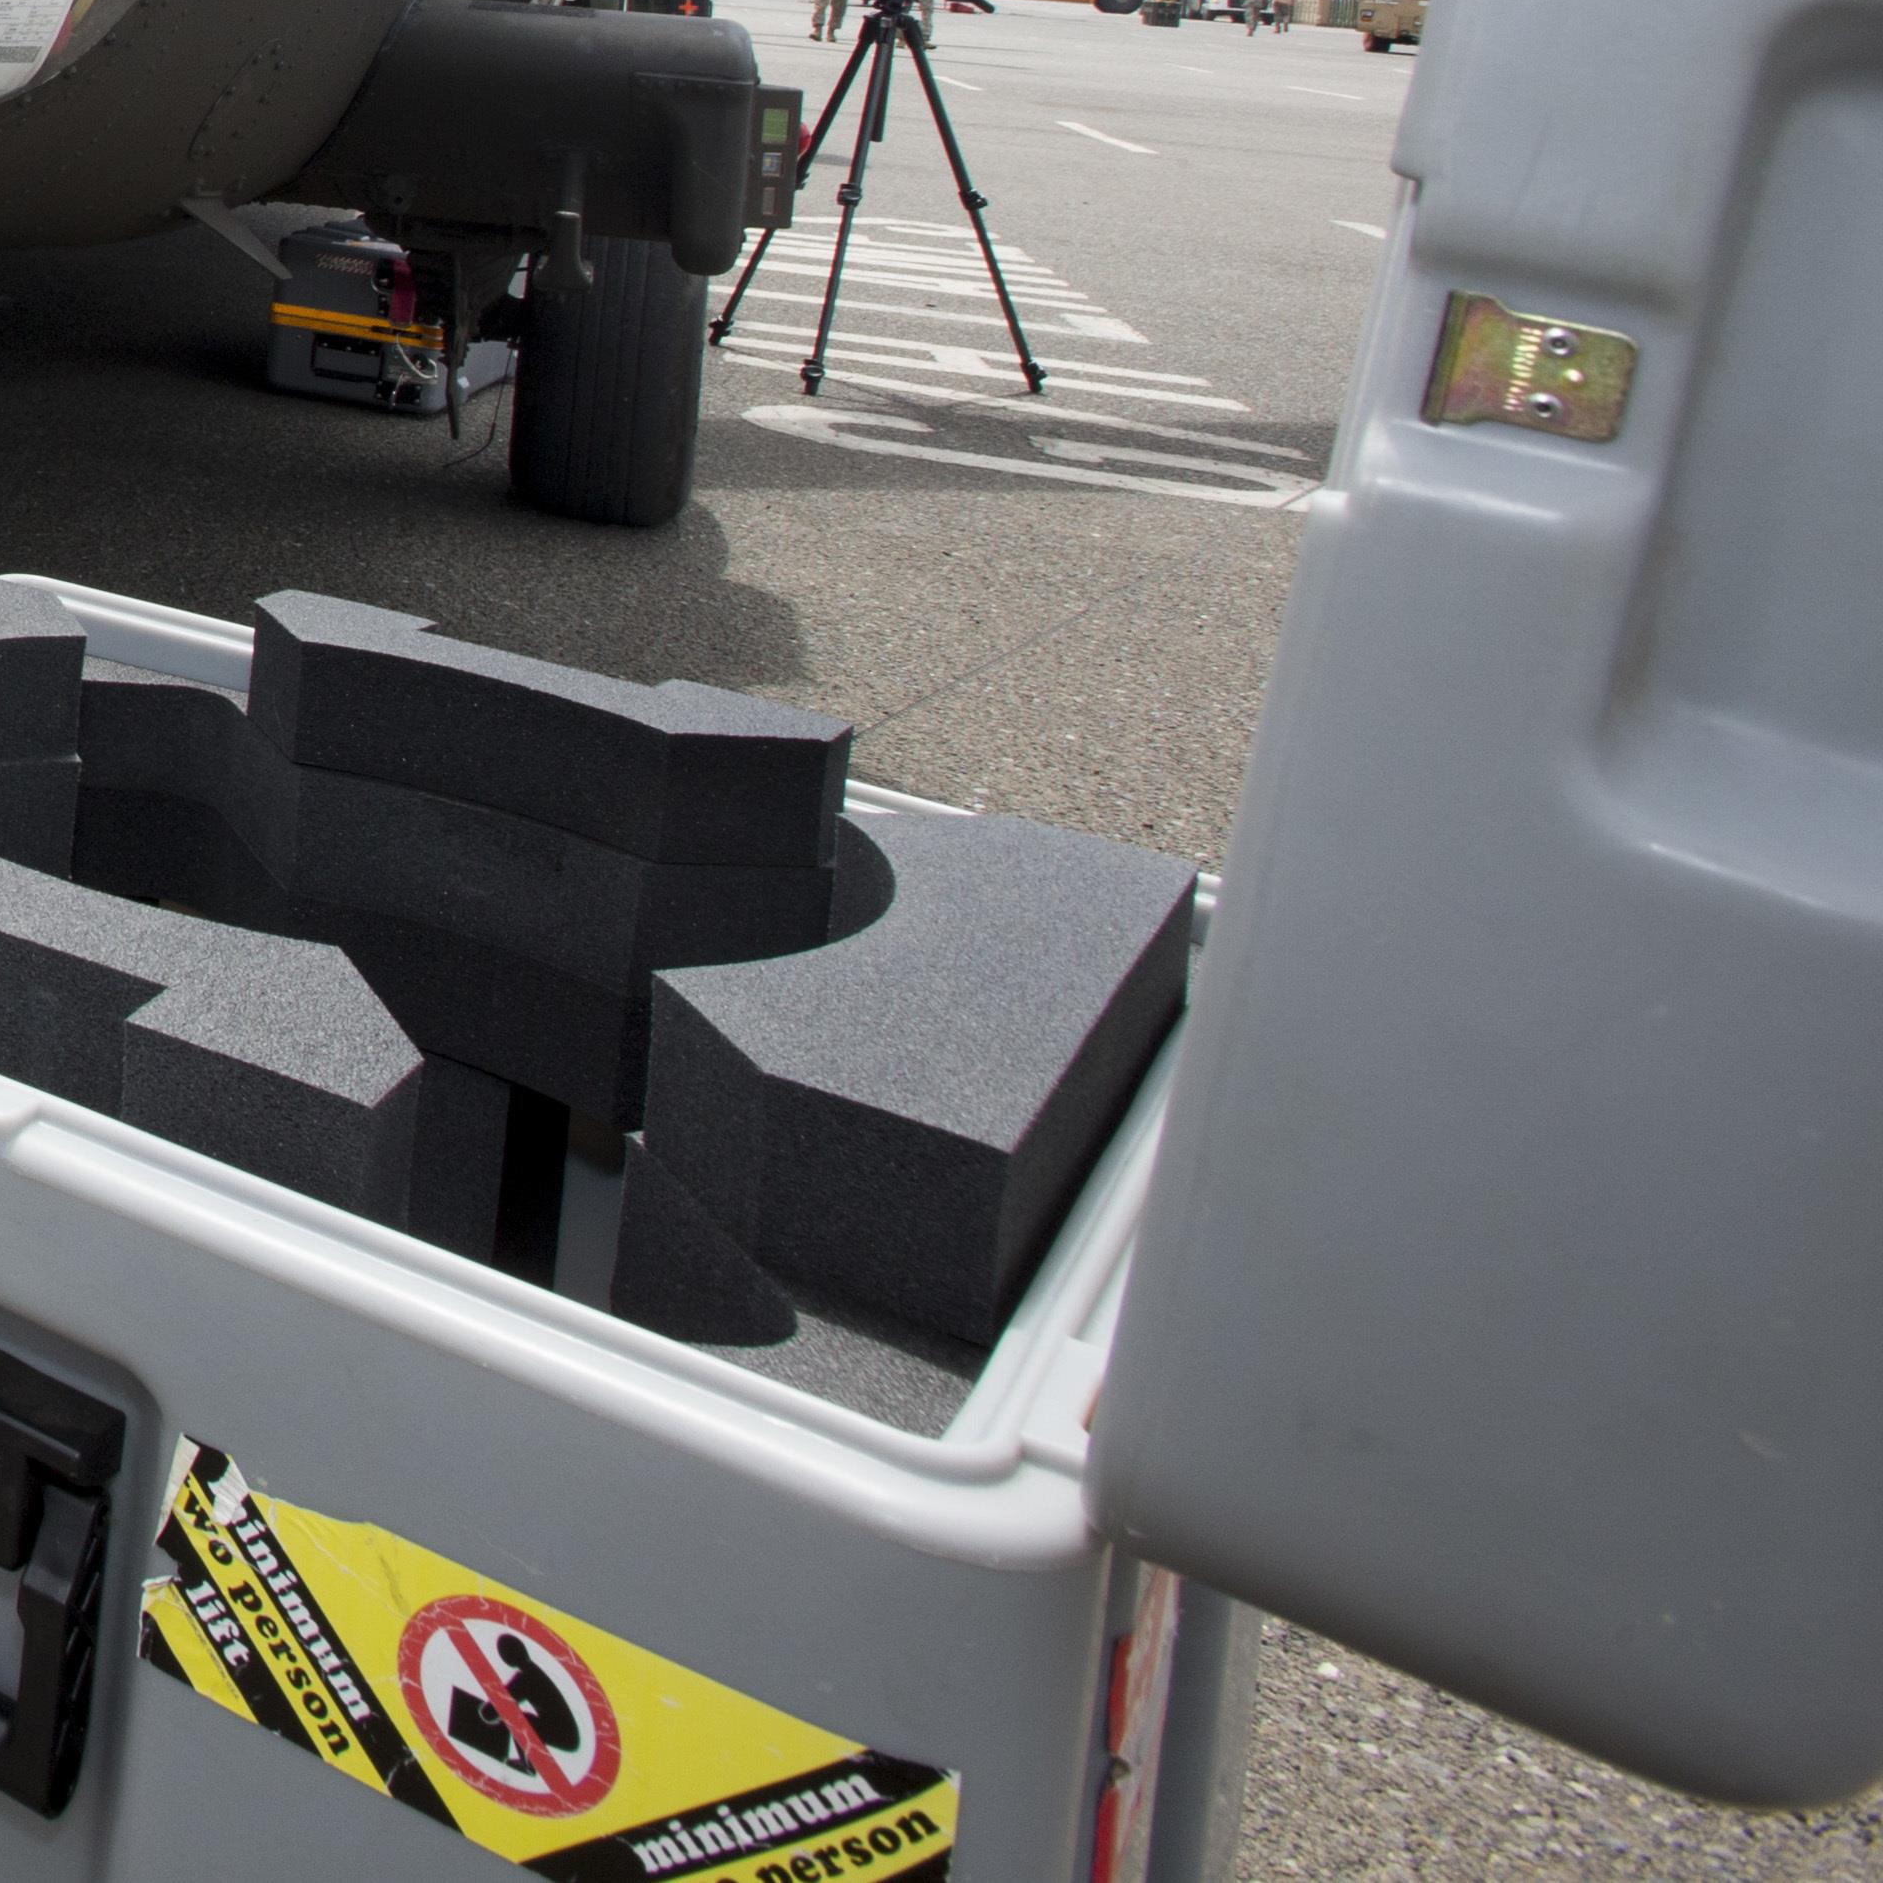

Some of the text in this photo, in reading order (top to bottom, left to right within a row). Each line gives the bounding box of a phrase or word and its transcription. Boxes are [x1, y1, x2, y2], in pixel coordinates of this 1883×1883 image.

[183, 1471, 234, 1566] wo
[228, 1579, 350, 1757] person
[185, 1579, 251, 1667] lift
[209, 1478, 371, 1724] inimum
[634, 1773, 885, 1874] minimum
